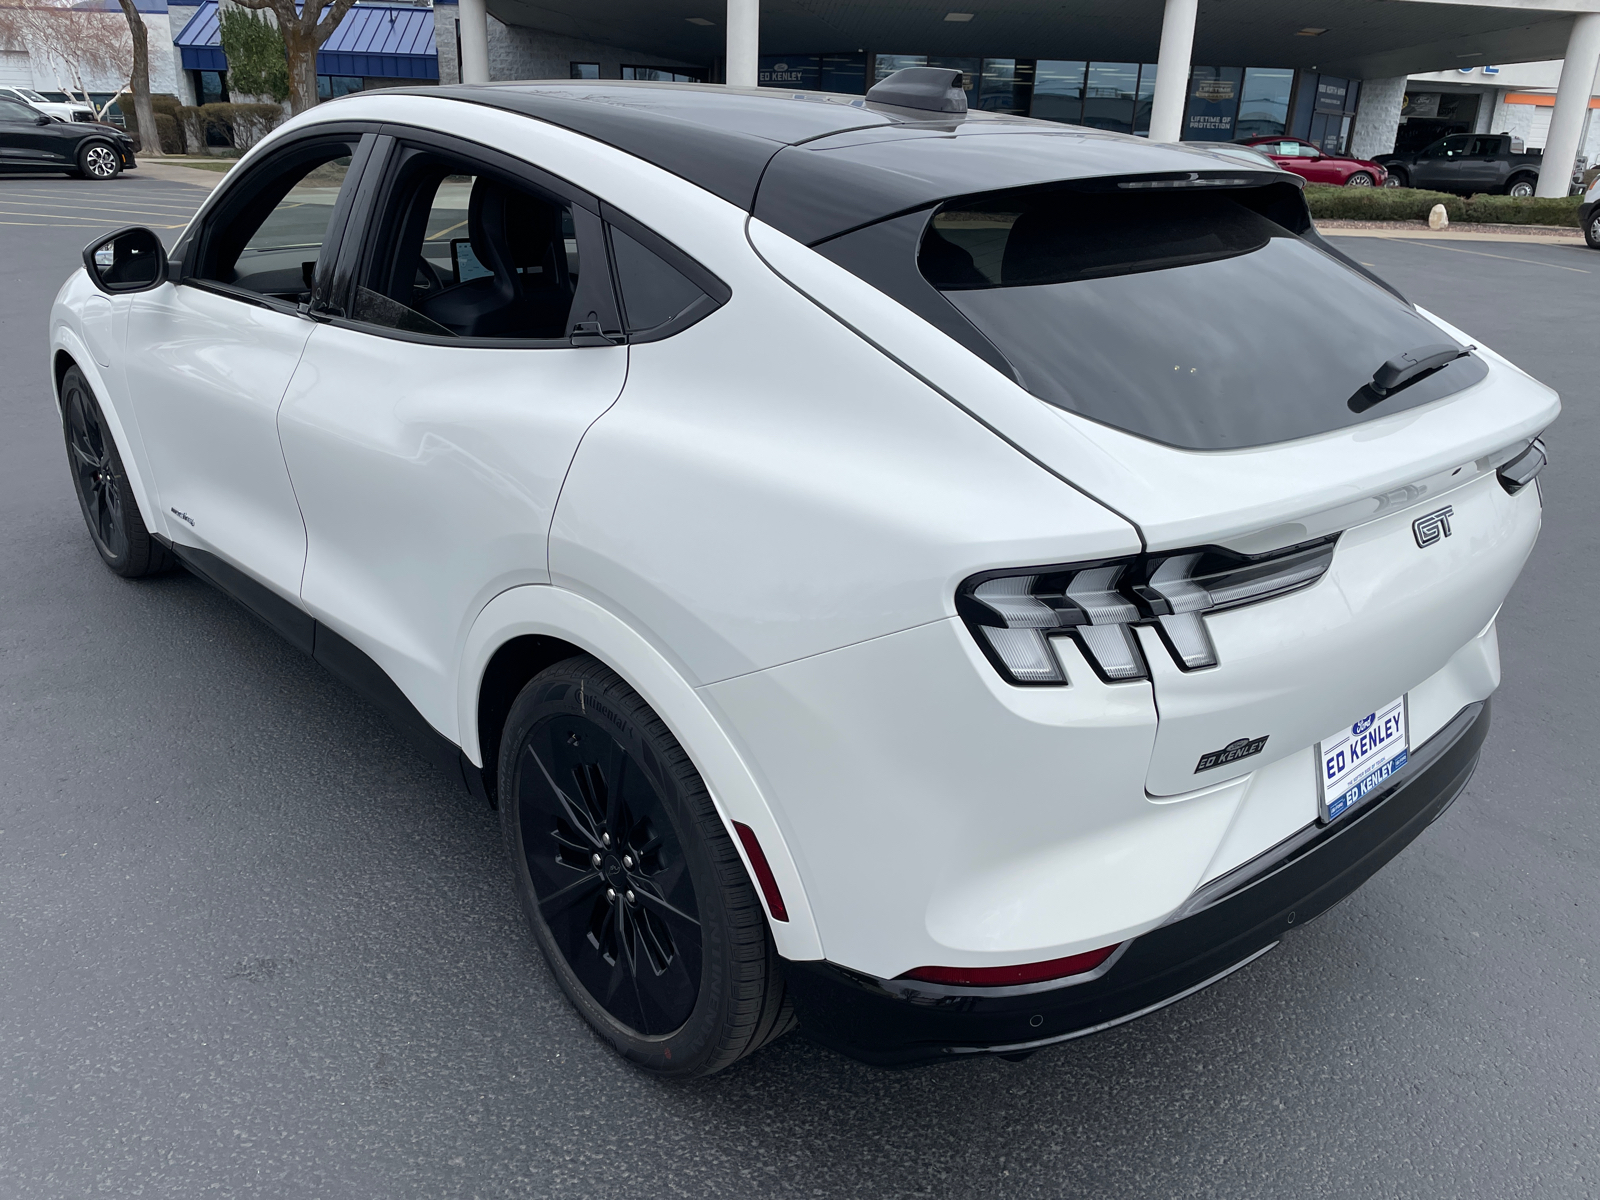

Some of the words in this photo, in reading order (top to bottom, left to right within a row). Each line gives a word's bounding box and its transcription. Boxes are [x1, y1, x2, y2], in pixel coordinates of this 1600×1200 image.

[772, 72, 802, 80] KENLEY
[1412, 505, 1454, 549] GT
[1198, 756, 1216, 769] ED
[1218, 740, 1266, 763] KENLEY
[1326, 750, 1345, 779] ED
[1350, 712, 1401, 763] KENLEY
[1346, 786, 1358, 806] ED
[1360, 761, 1393, 796] KENLEY
